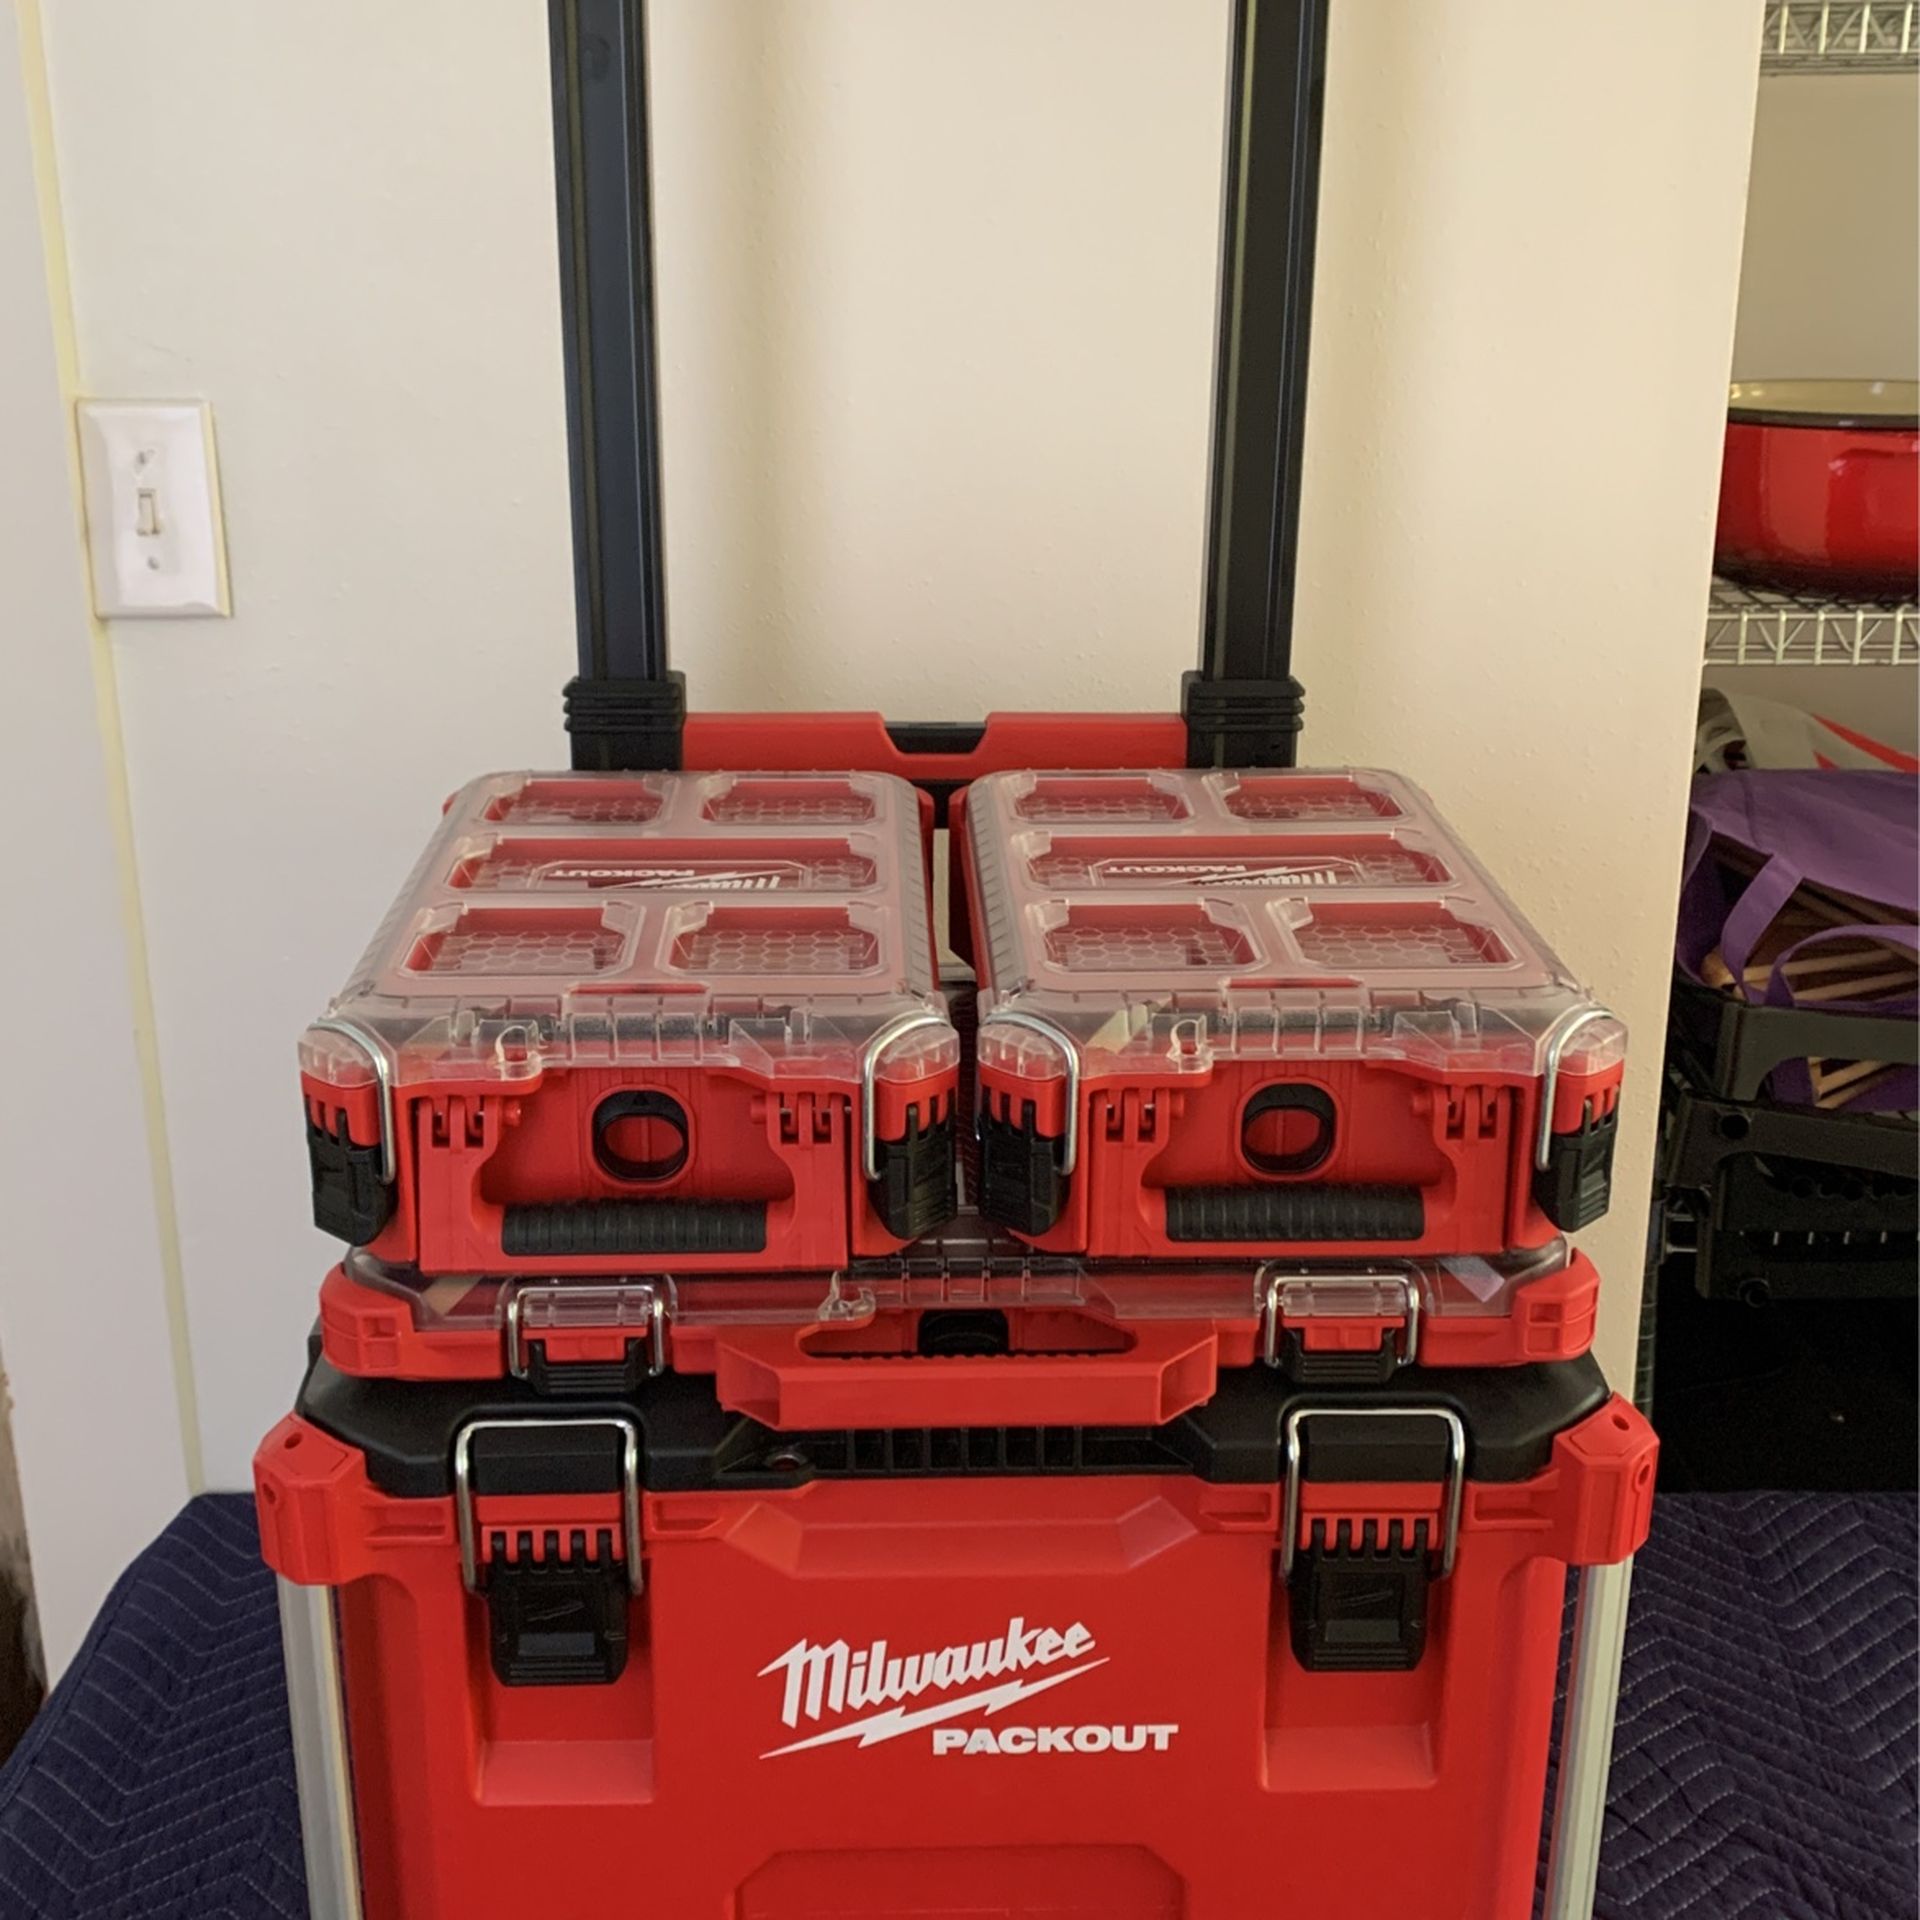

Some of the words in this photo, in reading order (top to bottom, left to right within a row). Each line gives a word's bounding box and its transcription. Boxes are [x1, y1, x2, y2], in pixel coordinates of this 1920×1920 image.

[549, 869, 695, 877] PACKOUT
[1105, 865, 1247, 874] PACKOUT
[757, 1617, 1096, 1728] Milwaukee
[932, 1724, 1179, 1756] PACKOUT
